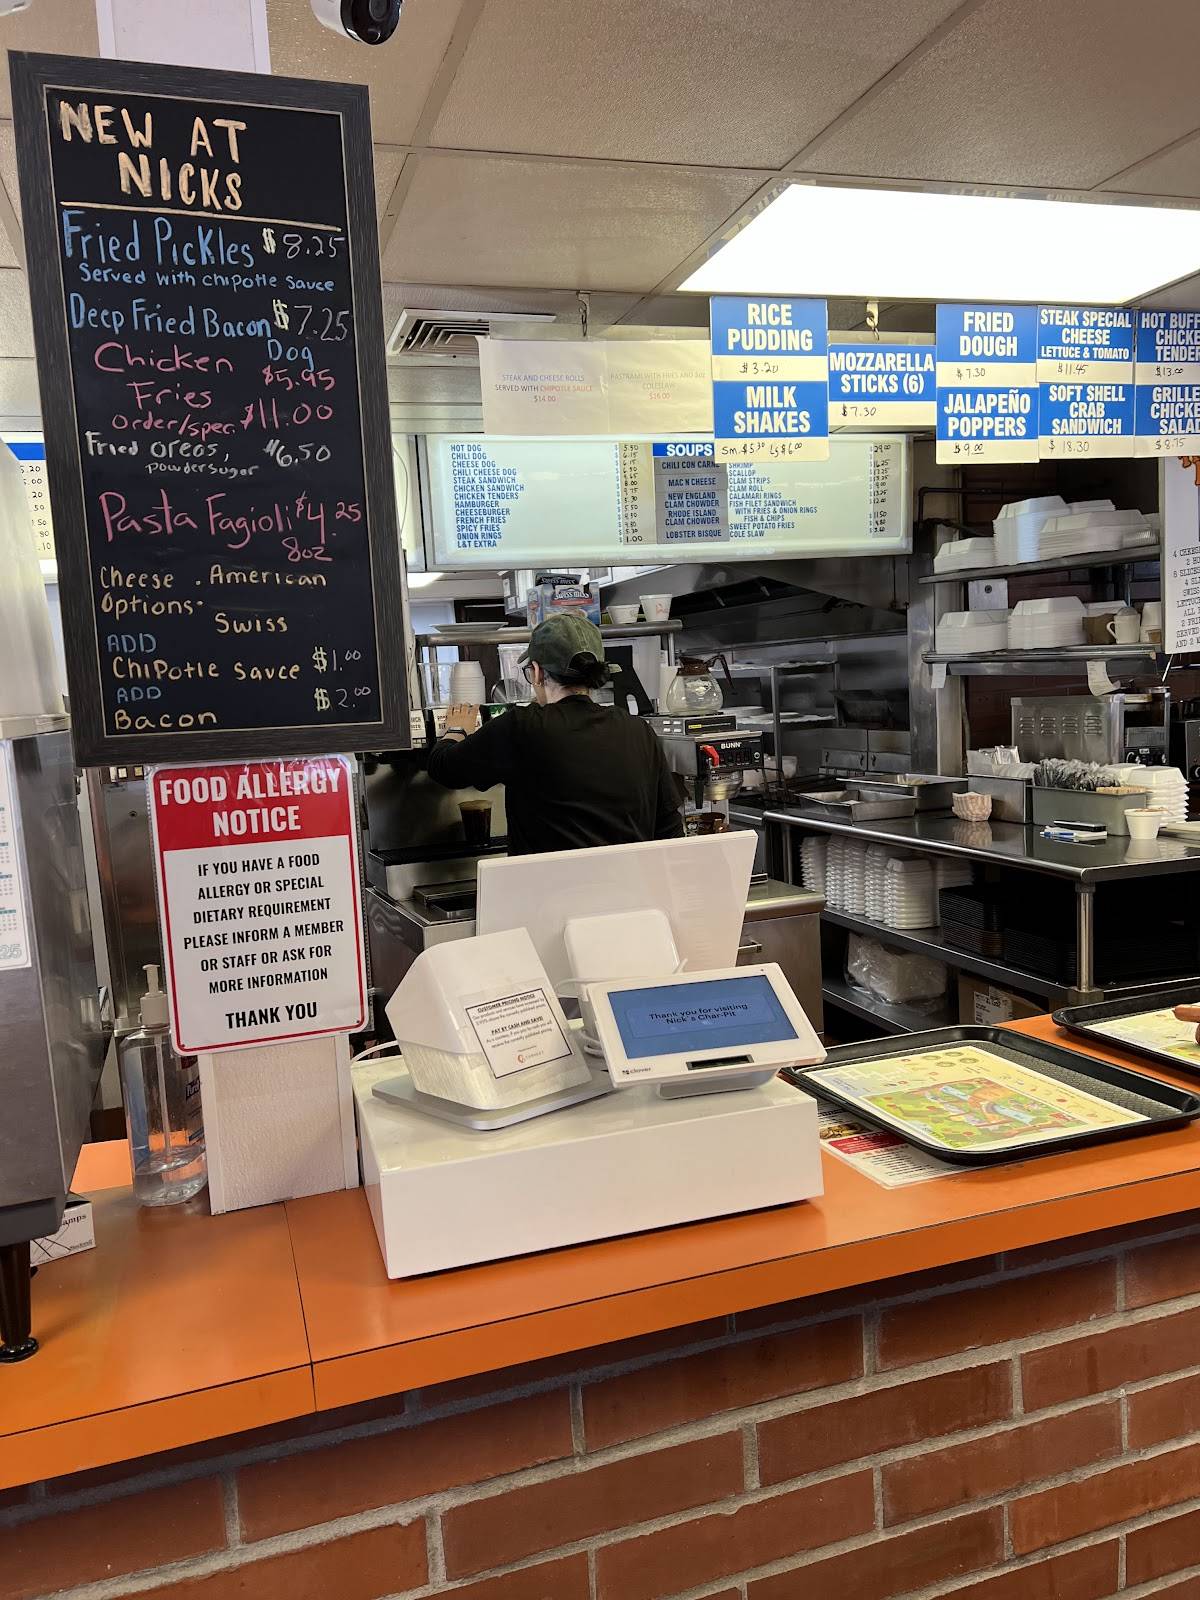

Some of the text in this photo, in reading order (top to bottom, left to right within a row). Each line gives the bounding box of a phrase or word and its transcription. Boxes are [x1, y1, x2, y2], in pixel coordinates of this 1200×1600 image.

[59, 101, 247, 163] NEW AT
[117, 151, 243, 211] NICKS
[62, 209, 140, 264] Fried
[262, 227, 345, 260] $8.25
[156, 271, 196, 287] with
[70, 292, 350, 342] Deep Fried Bacon $7.25
[747, 303, 792, 326] RICE
[963, 311, 1014, 333] FRIED
[1040, 308, 1132, 328] STEAK SPECIAL
[1142, 313, 1166, 328] HOT
[727, 328, 813, 351] PUDDING
[959, 335, 1018, 357] DOUGH
[1062, 327, 1110, 345] CHEESE
[1156, 330, 1200, 345] CHICKE
[267, 338, 315, 372] Dog
[829, 352, 935, 372] MOZZARELLA
[1041, 346, 1130, 360] LETTUCE & TOMATO
[94, 340, 335, 392] Chicken $5.95
[520, 384, 538, 392] WITH
[840, 373, 925, 394] STICKS (6)
[1049, 384, 1126, 402] SOFT SHELL
[1152, 387, 1200, 402] GRILLE
[126, 381, 213, 410] Fries
[746, 386, 797, 408] MILK
[944, 388, 1031, 415] JALAPEÑO
[241, 397, 333, 430] $11.00
[1069, 402, 1106, 419] CRAB
[1150, 403, 1200, 419] CHICKE
[734, 411, 811, 434] SHAKES
[948, 416, 1027, 438] POPPERS
[1052, 418, 1122, 435] SANDWICH
[85, 430, 138, 456] Fried
[666, 444, 712, 456] SOUPS
[668, 479, 683, 487] MAC
[691, 478, 716, 486] CHEESE
[686, 492, 716, 500] ENGLAND
[686, 500, 720, 508] CHOWDER
[99, 489, 198, 542] Pasta
[206, 493, 292, 549] Fagioli
[665, 517, 720, 526] CLAM CHOWDER
[668, 510, 690, 518] RHODE
[666, 529, 722, 538] LOBSTER BISQUE
[100, 564, 326, 588] Cheese American
[215, 613, 288, 633] Swiss
[107, 633, 157, 653] ADD
[117, 686, 162, 703] ADD
[114, 709, 217, 730] Bacon
[159, 767, 342, 806] FOOD ALLERGY
[212, 806, 301, 837] NOTICE
[198, 853, 320, 877] IF YOU HAVE A FOOD
[198, 875, 324, 901] ALLERGY OR SPECIAL
[193, 897, 332, 924] DIETARY REQUIREMENT
[184, 920, 344, 950] PLEASE INFORM A MEMBER
[200, 944, 332, 972] OR STAFF OR ASK FOR
[209, 967, 328, 994] MORE INFORMATION
[225, 1001, 318, 1030] THANK YOU
[649, 1012, 679, 1020] Thank
[714, 1004, 748, 1012] visiting
[697, 1011, 736, 1021] Char-Pit
